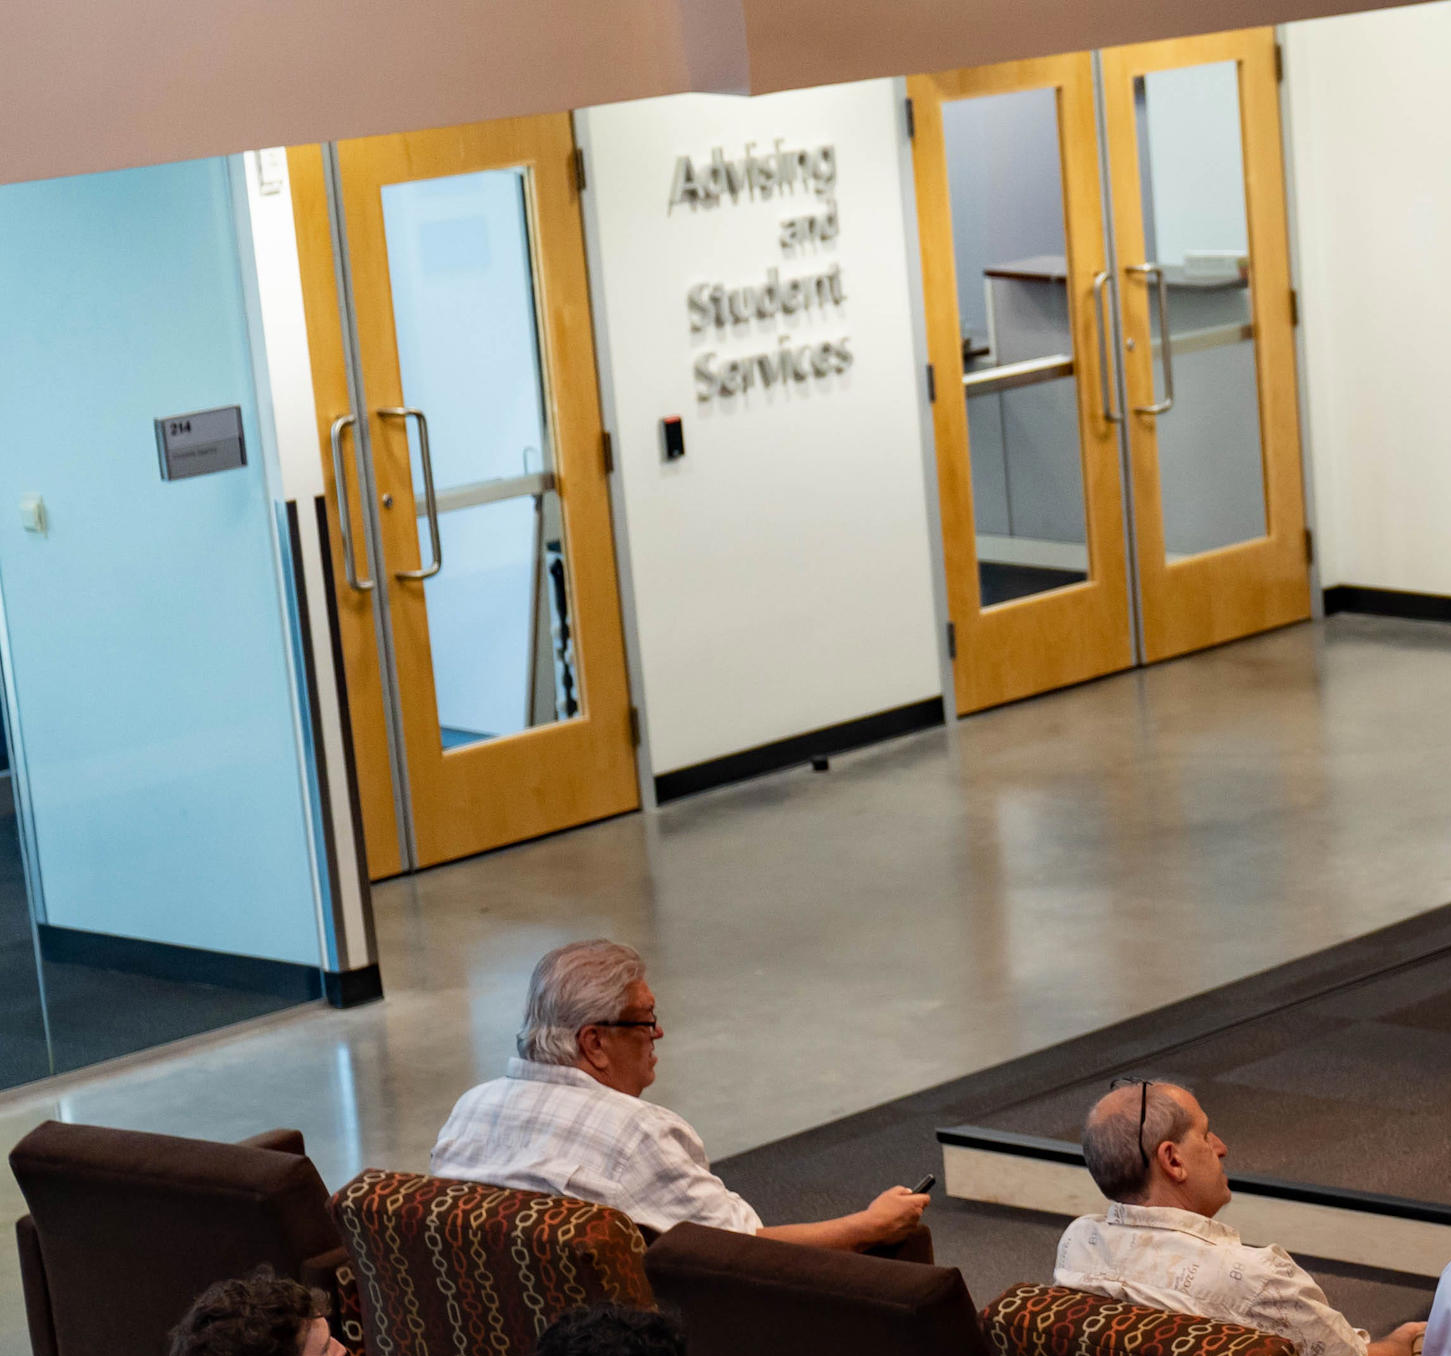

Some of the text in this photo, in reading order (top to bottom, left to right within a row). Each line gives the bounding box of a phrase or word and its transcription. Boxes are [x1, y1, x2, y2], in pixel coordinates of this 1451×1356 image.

[669, 138, 838, 214] Advising
[780, 198, 840, 250] and
[687, 263, 847, 334] Student
[694, 334, 854, 403] Services
